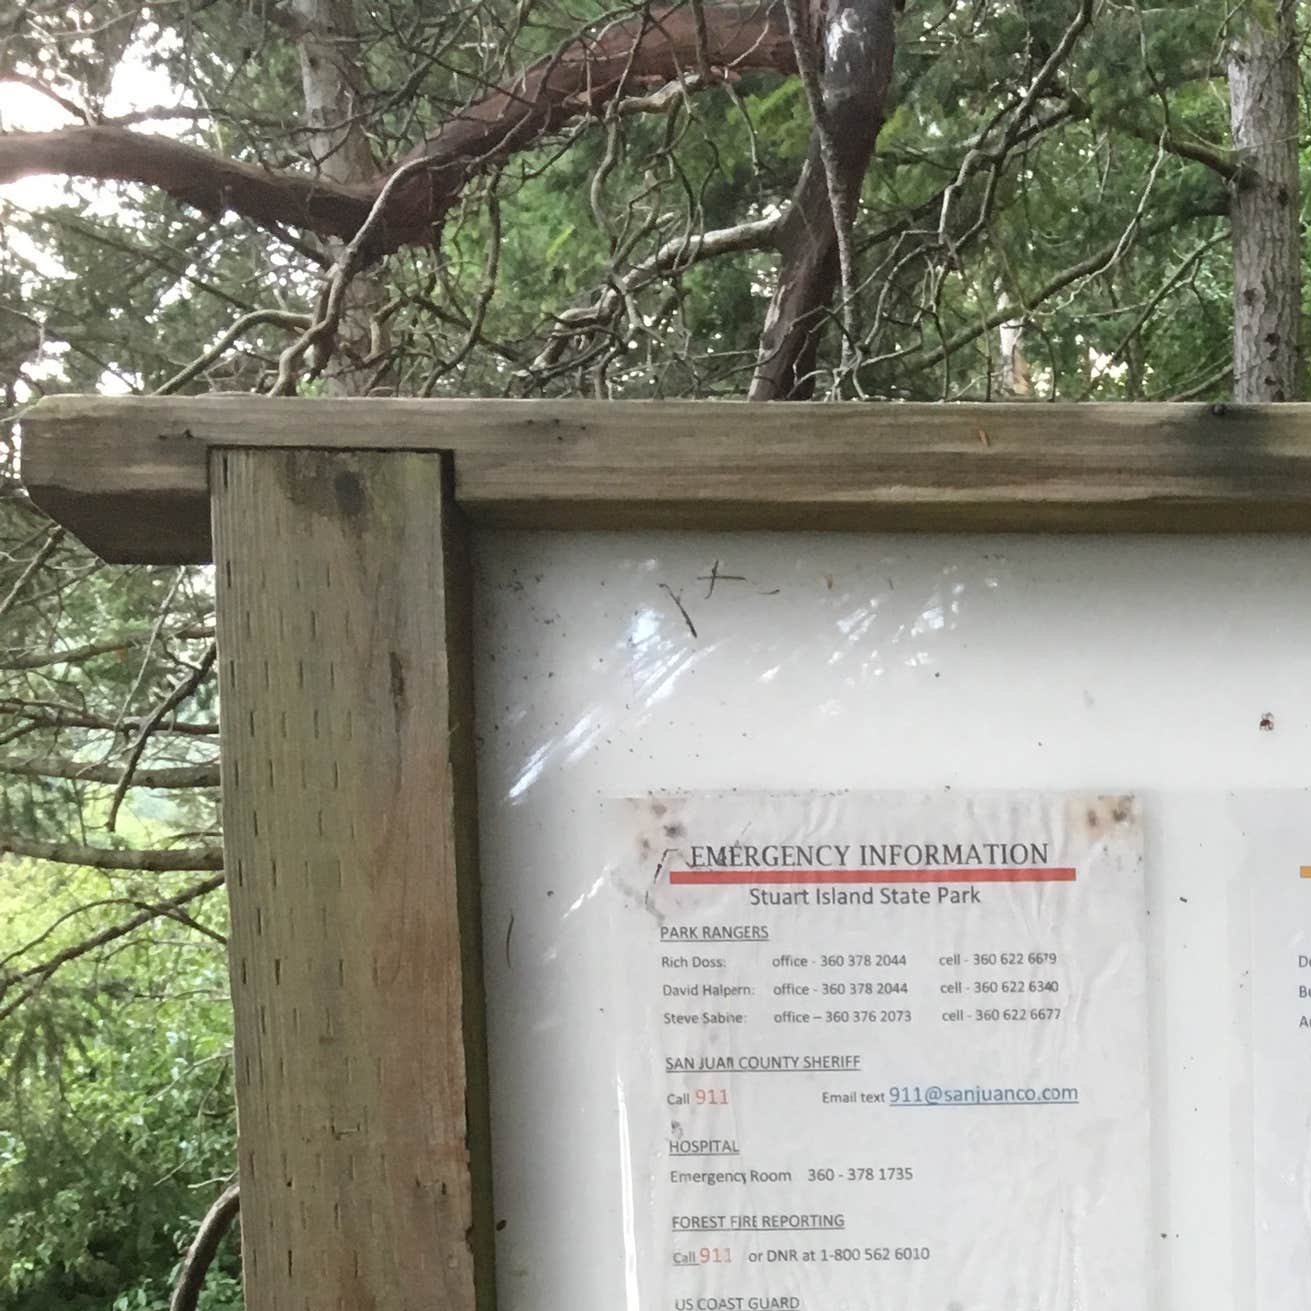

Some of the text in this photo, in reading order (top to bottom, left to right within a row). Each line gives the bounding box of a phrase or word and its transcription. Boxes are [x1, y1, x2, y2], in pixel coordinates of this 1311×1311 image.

[691, 843, 1049, 868] EMERGENCY INFORMATION
[749, 886, 981, 906] Stuart Island State Park
[660, 925, 769, 939] PARK RANGERS
[661, 956, 688, 968] Rich
[692, 956, 727, 968] Doss:
[772, 955, 808, 967] office
[820, 955, 844, 967] 360
[848, 955, 872, 967] 378
[875, 954, 907, 967] 2044
[939, 954, 961, 966] cell
[973, 953, 997, 965] 360
[1000, 953, 1024, 965] 622
[662, 984, 699, 996] David
[773, 983, 810, 996] office
[822, 983, 845, 995] 360
[850, 983, 873, 995] 378
[877, 983, 908, 995] 2044
[940, 982, 962, 994] cell
[974, 981, 998, 993] 360
[1001, 981, 1025, 993] 622
[1029, 981, 1059, 992] 6340
[664, 1012, 699, 1024] Steve
[774, 1011, 810, 1023] office
[825, 1011, 849, 1023] 360
[853, 1011, 877, 1023] 376
[879, 1010, 912, 1022] 2073
[942, 1010, 964, 1021] cell
[975, 1009, 1000, 1021] 360
[1003, 1009, 1026, 1021] 622
[1030, 1008, 1062, 1020] 6677
[665, 1056, 695, 1070] SAN
[738, 1056, 800, 1070] COUNTY
[803, 1055, 861, 1069] SHERIFF
[667, 1092, 690, 1106] Call
[695, 1089, 730, 1105] 911
[822, 1091, 858, 1105] Email
[860, 1091, 886, 1104] text
[668, 1139, 740, 1153] HOSPITAL
[670, 1167, 914, 1186] Emergency Room 360 378 1735
[672, 1214, 845, 1230] FOREST FIRE REPORTING
[672, 1247, 931, 1264] Call 911 or DNR at 1-800 562 6010
[675, 1296, 800, 1311] US COAST GUARD
